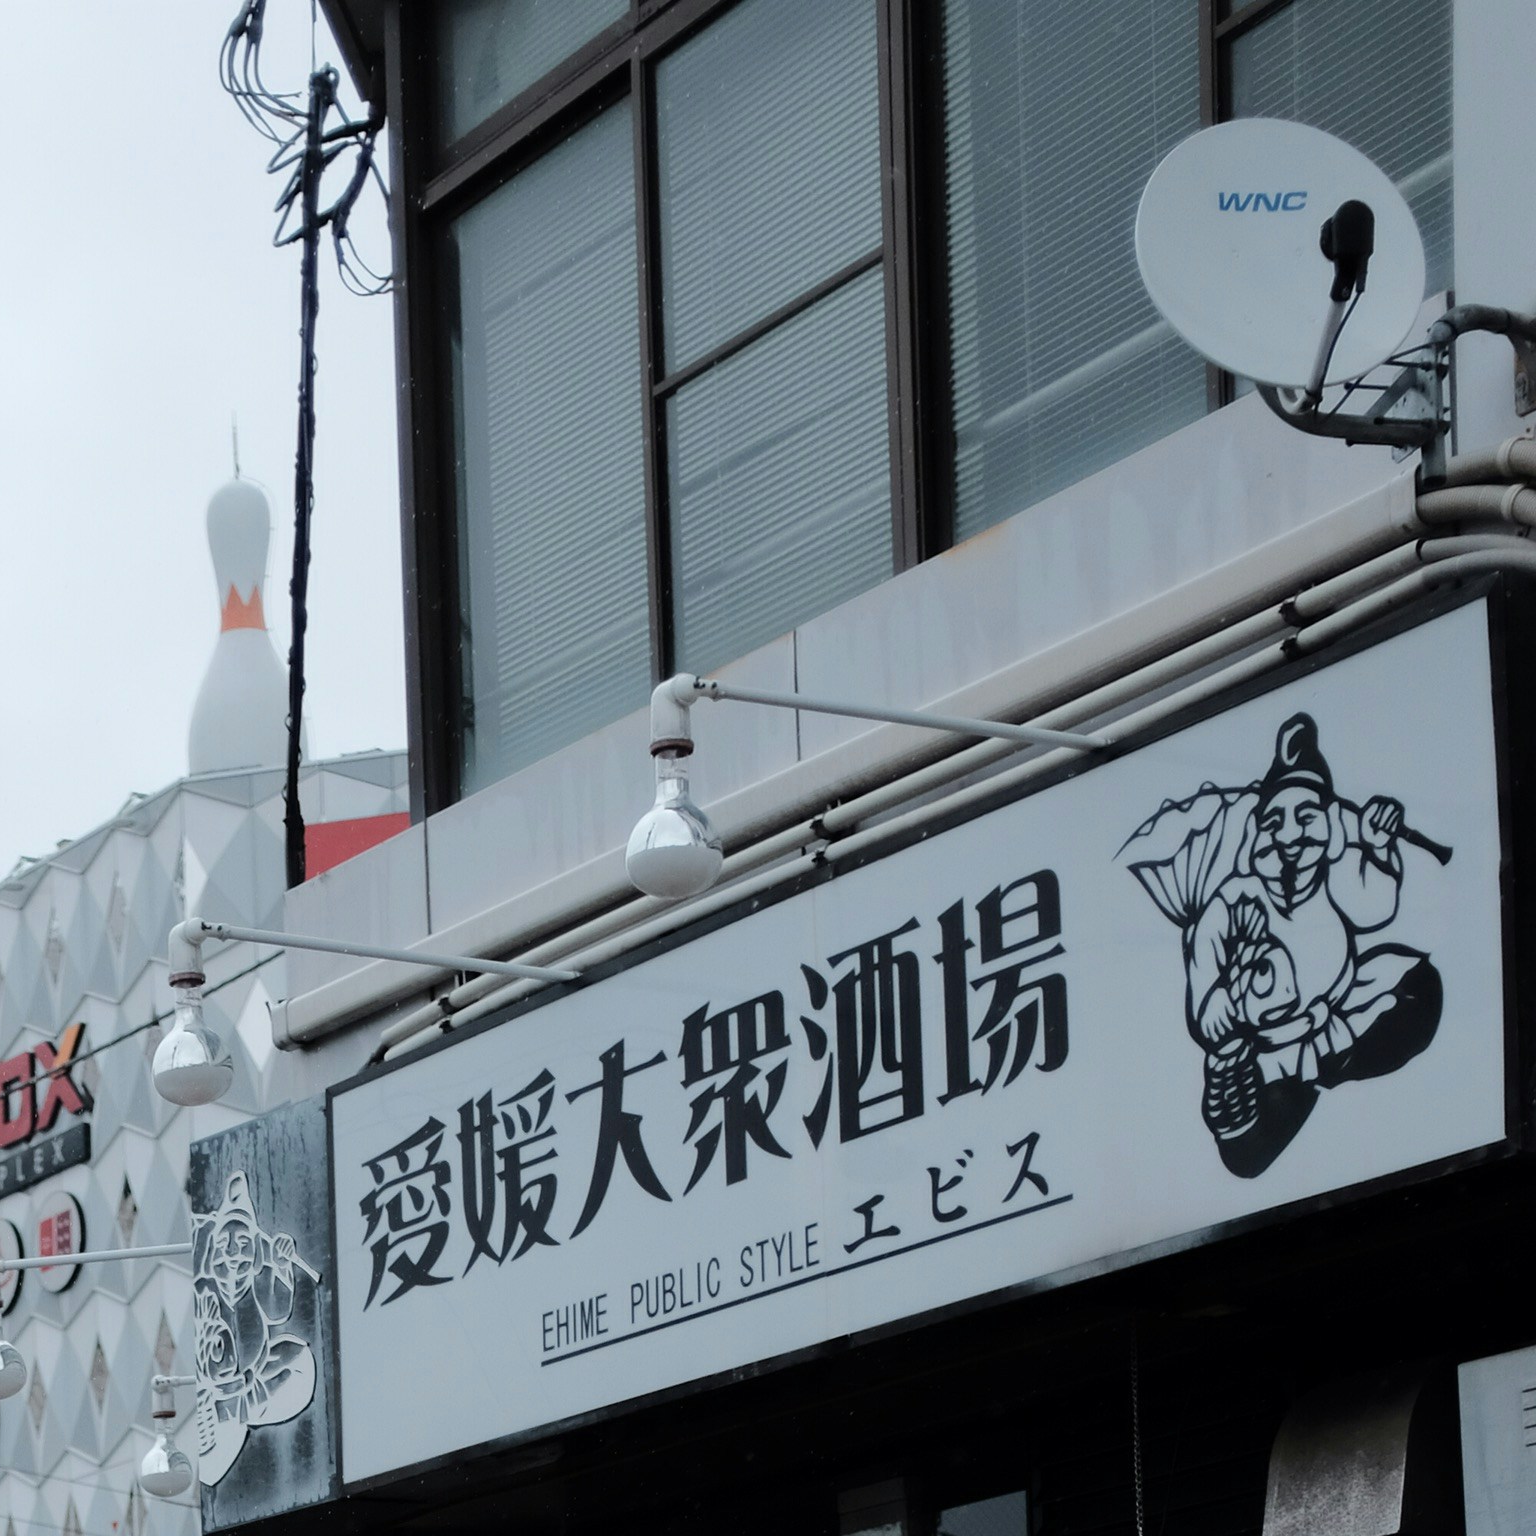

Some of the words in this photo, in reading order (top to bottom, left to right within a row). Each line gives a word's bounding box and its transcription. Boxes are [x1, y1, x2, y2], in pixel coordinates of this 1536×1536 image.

[1217, 191, 1308, 212] WNC
[361, 867, 1072, 1311] 愛媛大衆酒場
[541, 1294, 609, 1352] EHIME
[629, 1257, 722, 1325] PUBLIC
[739, 1223, 820, 1288] STYLE
[843, 1131, 1051, 1255] エビス
